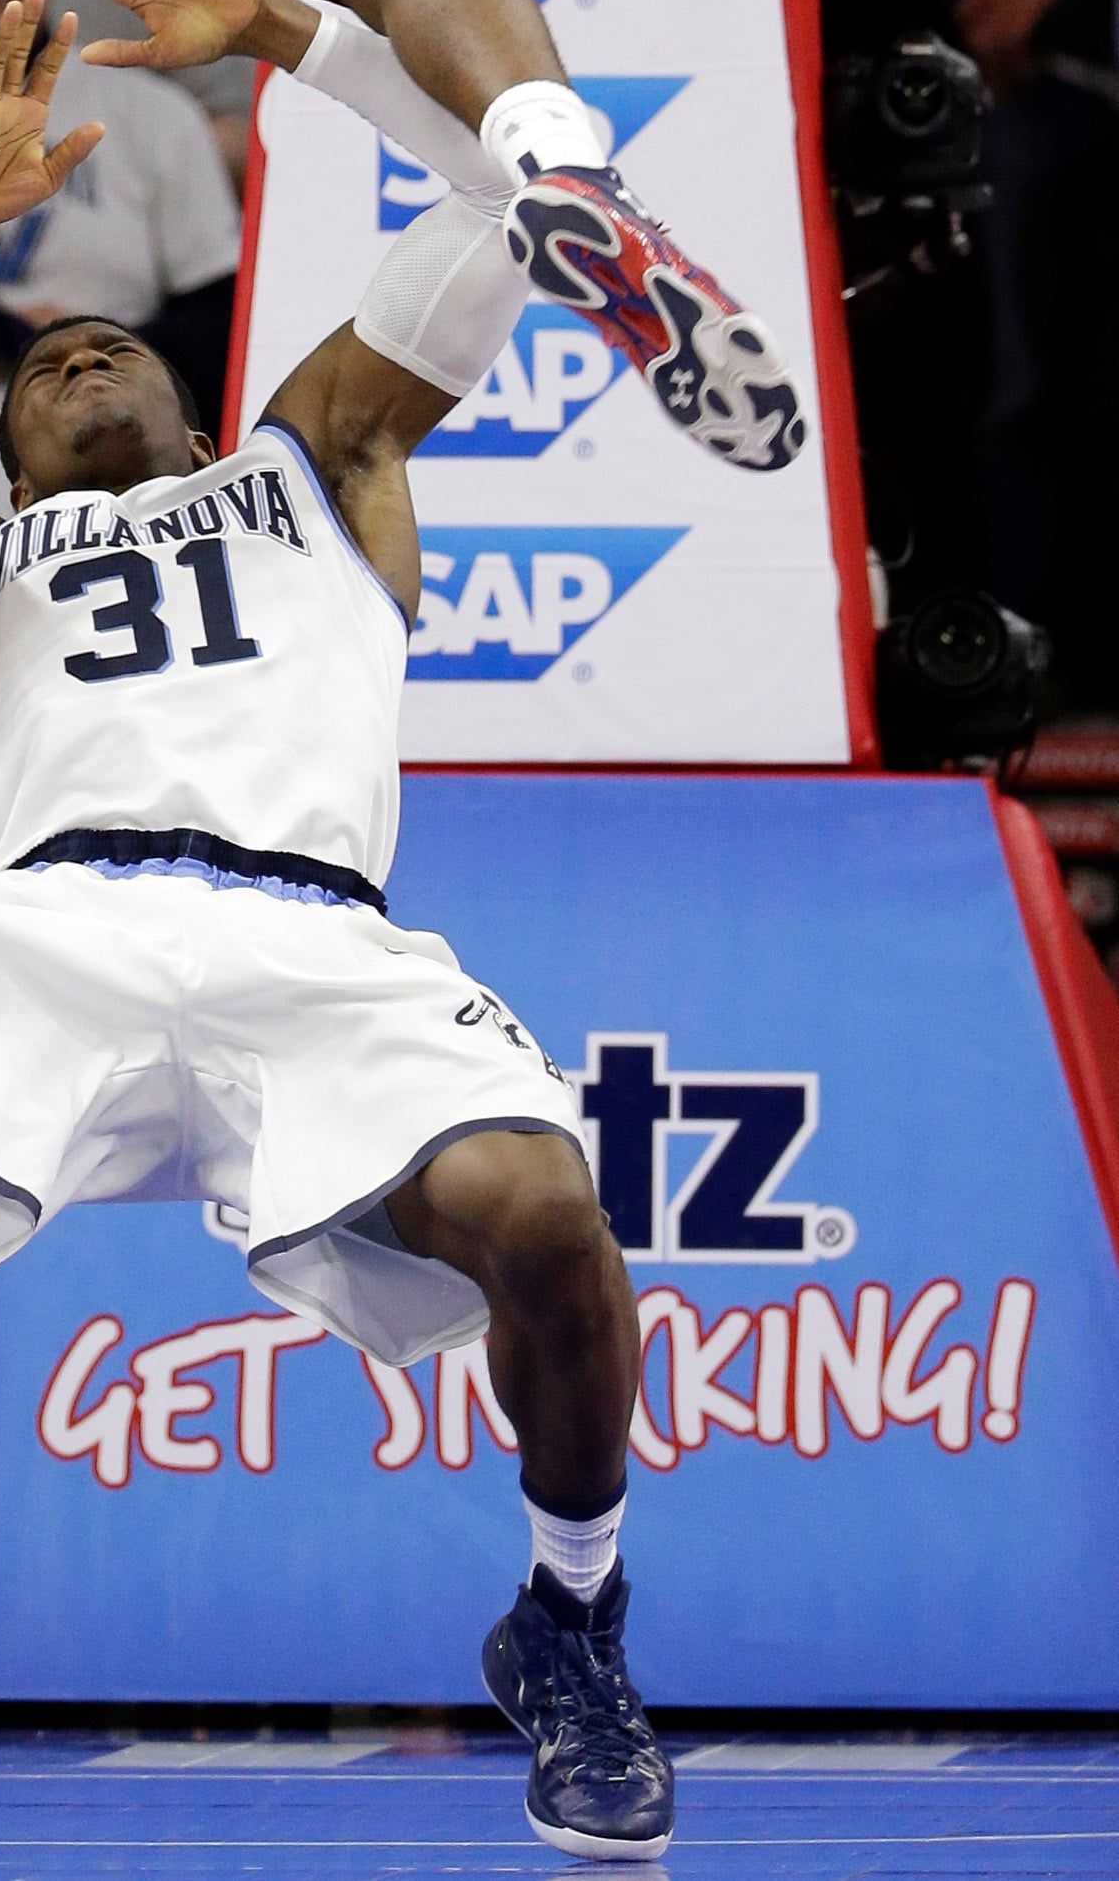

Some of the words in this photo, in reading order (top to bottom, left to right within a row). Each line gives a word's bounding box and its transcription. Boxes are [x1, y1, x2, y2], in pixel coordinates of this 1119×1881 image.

[437, 329, 613, 432] AP
[49, 538, 263, 684] 31
[37, 1314, 327, 1489] GET
